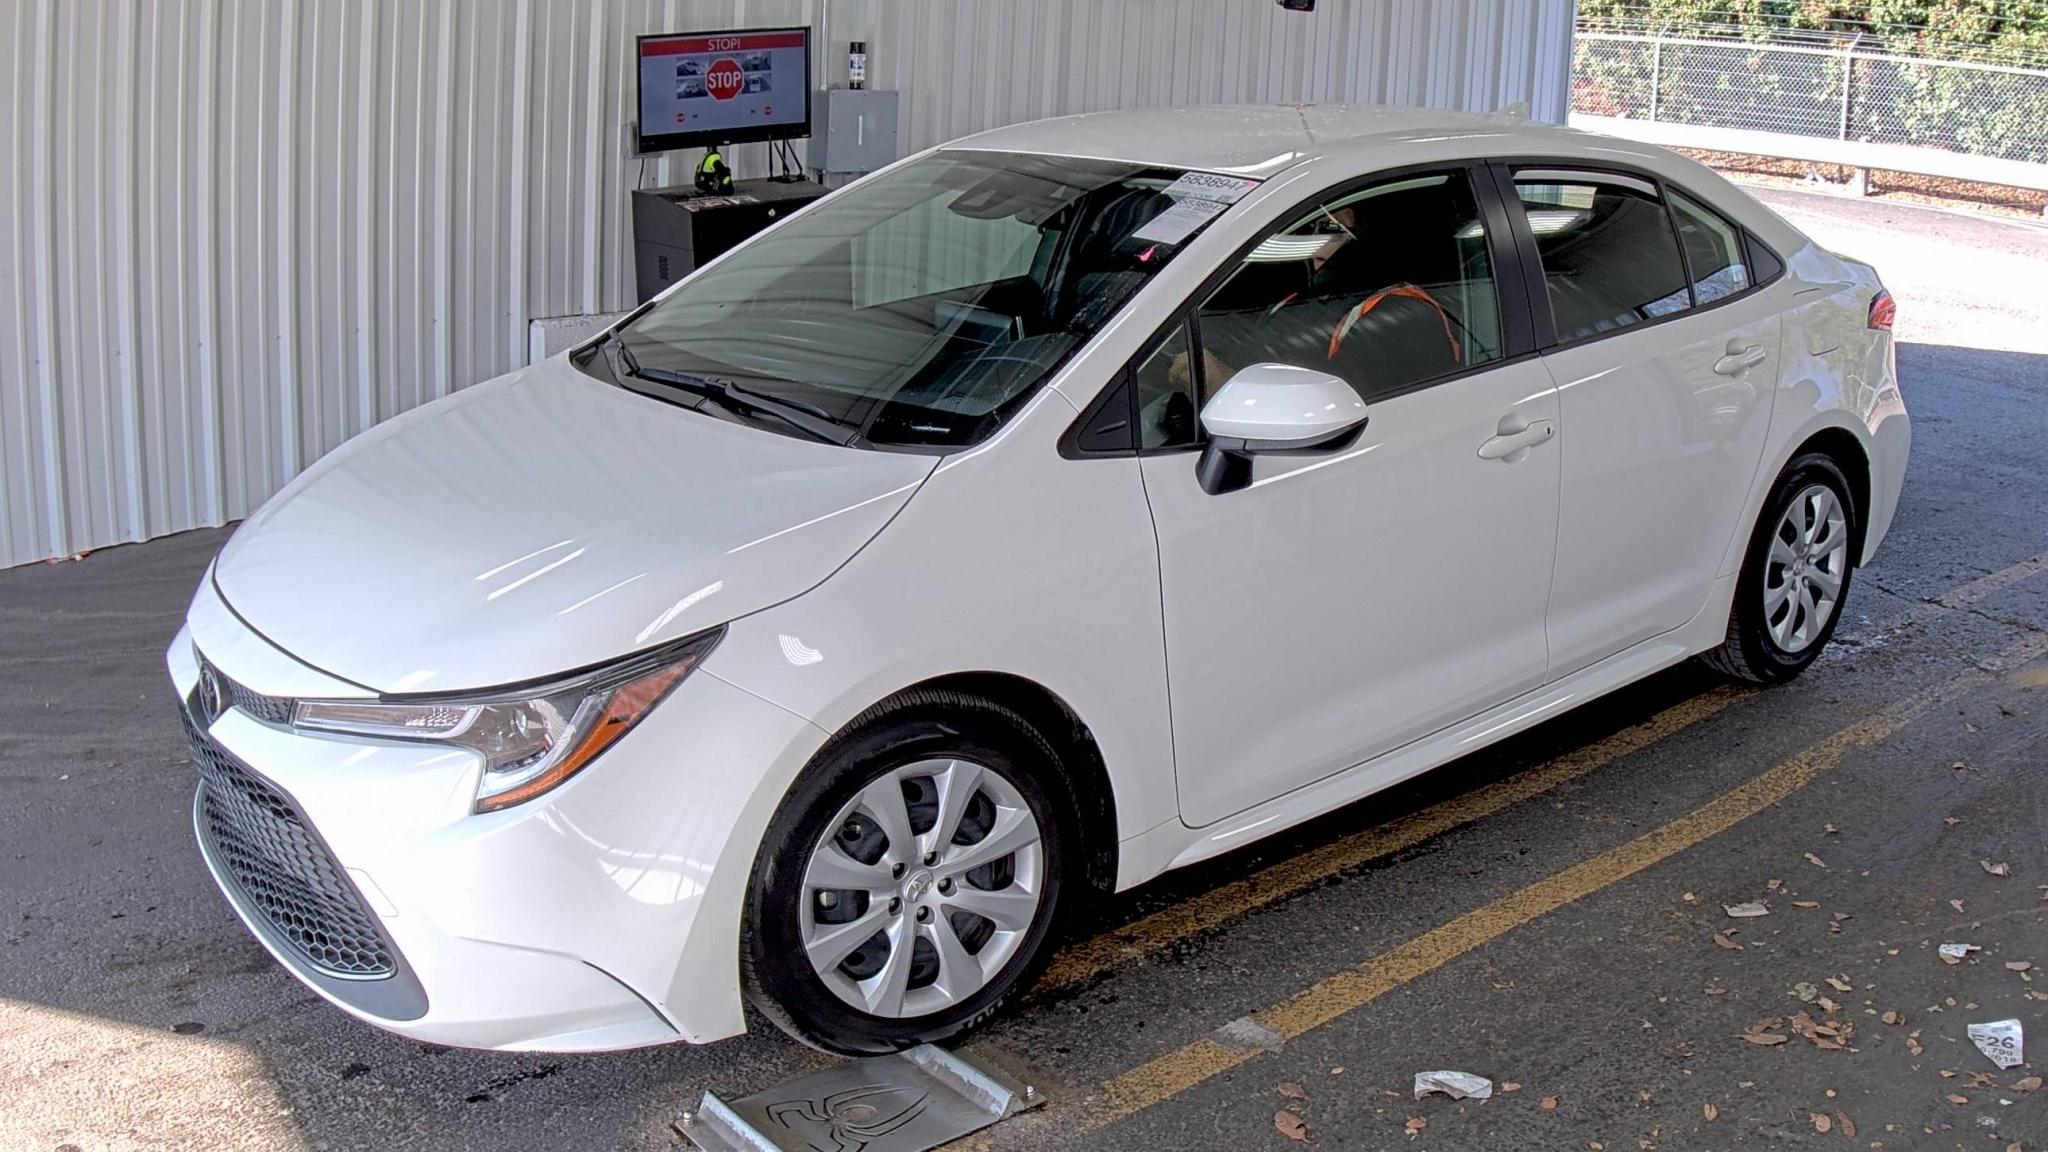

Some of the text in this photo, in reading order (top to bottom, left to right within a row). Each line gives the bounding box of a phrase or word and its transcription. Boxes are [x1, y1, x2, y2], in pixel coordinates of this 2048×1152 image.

[707, 38, 741, 51] STOP!
[708, 72, 742, 89] STOP
[1179, 174, 1250, 191] 5838947
